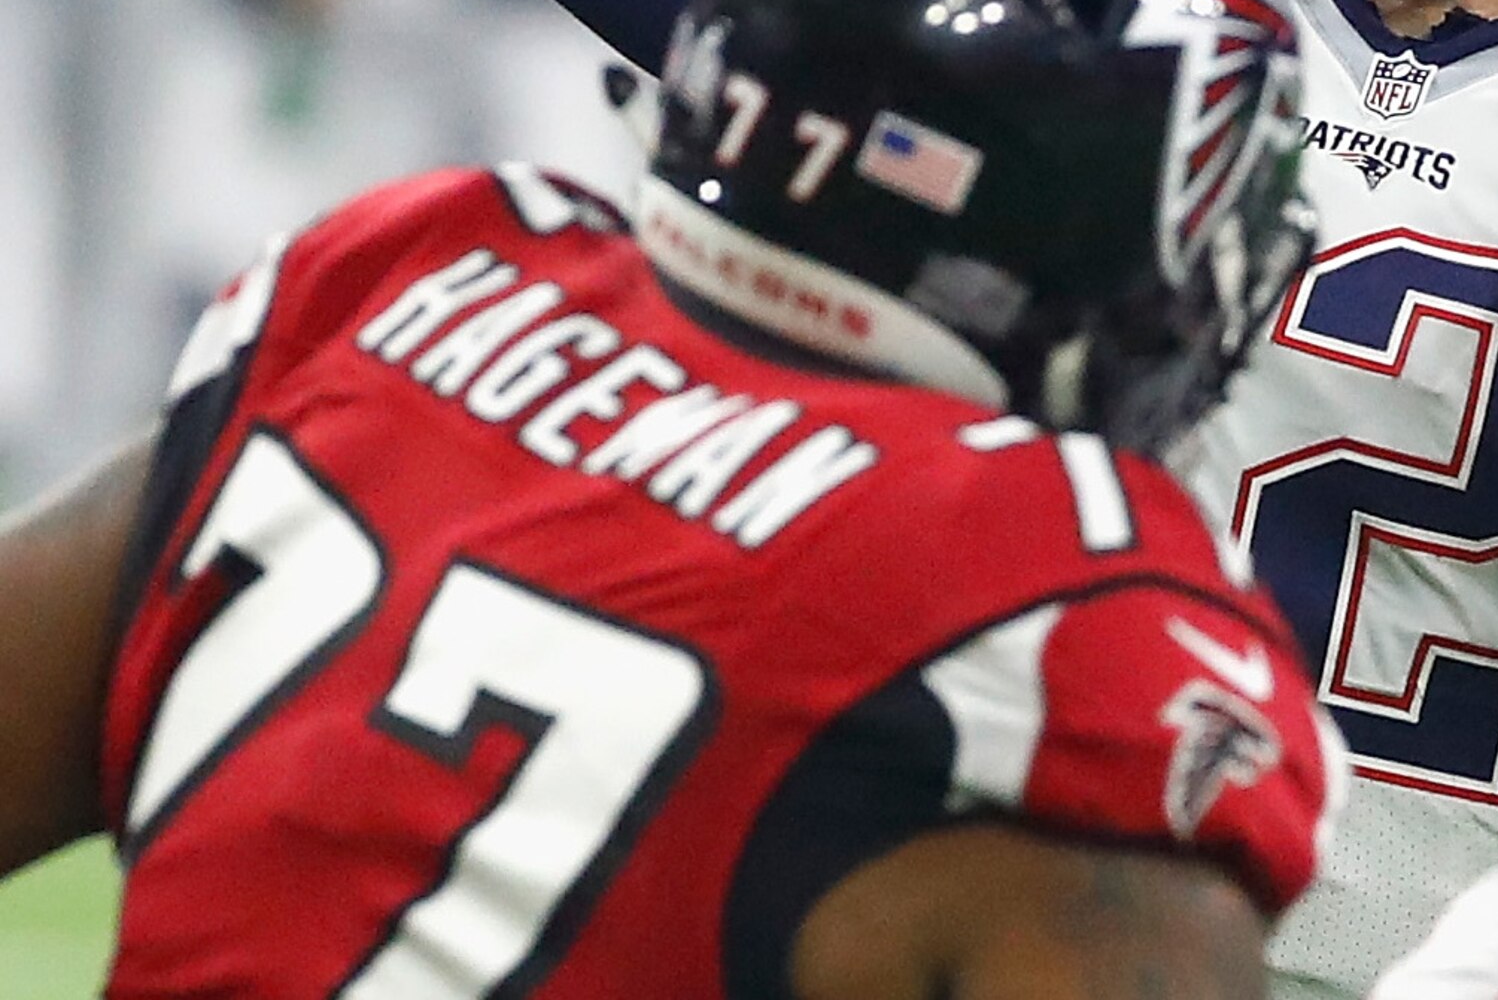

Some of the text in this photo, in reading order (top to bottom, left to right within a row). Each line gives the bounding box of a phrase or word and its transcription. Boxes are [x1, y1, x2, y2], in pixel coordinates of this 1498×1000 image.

[713, 70, 850, 203] 77
[1369, 80, 1412, 112] NFL
[355, 246, 880, 552] HAGEMAN
[118, 421, 722, 1000] 77
